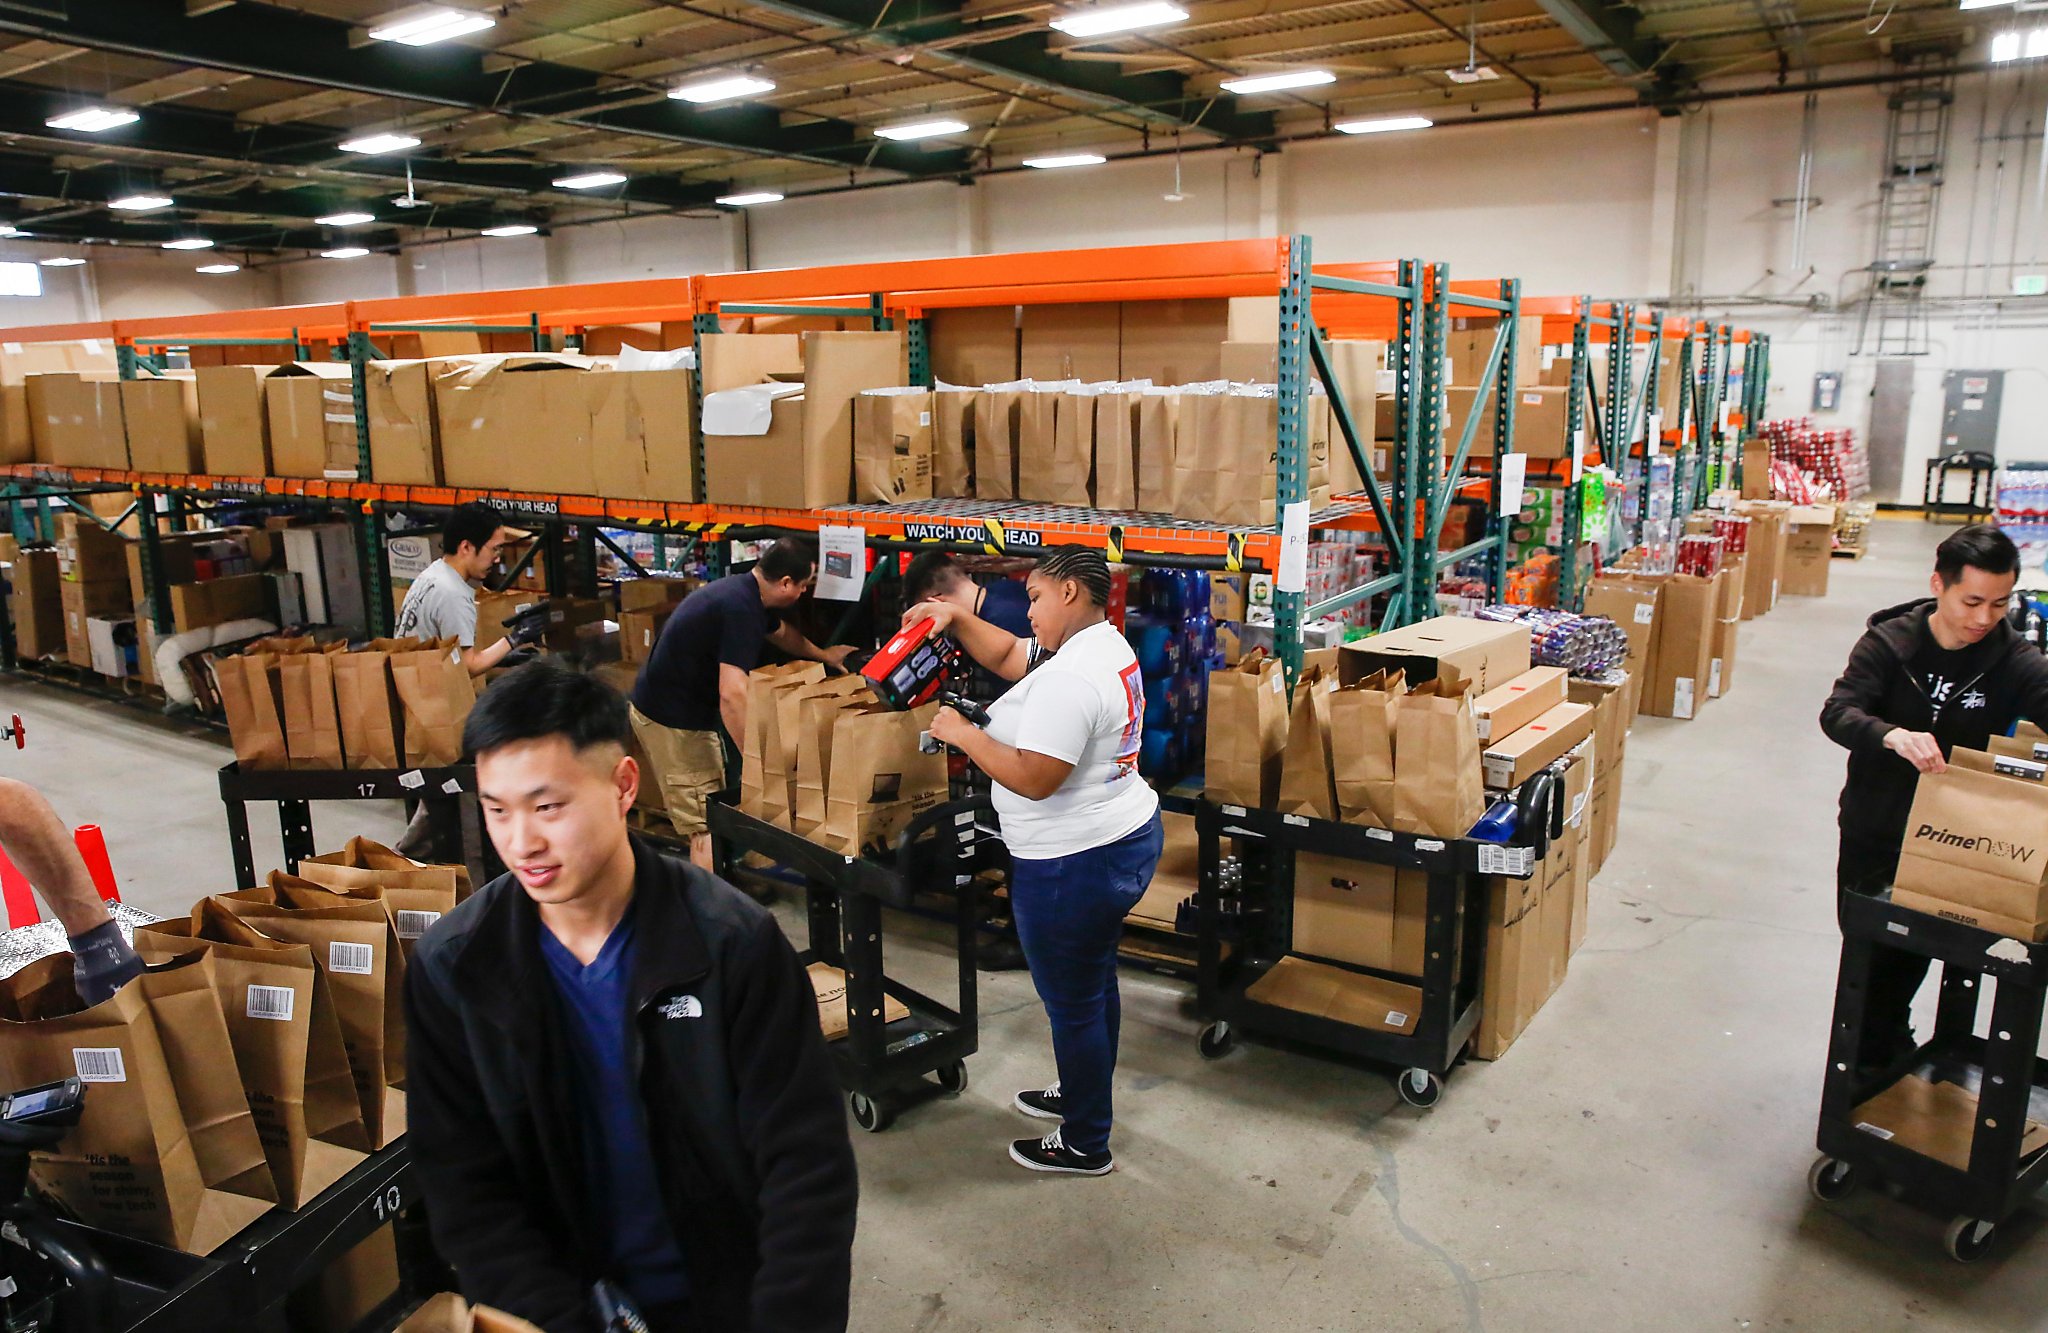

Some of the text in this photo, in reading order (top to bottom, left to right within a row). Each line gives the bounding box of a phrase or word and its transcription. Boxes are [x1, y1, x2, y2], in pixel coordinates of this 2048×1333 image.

[212, 482, 265, 494] WACH YUR HEA
[533, 502, 557, 514] HEAD
[907, 524, 1040, 546] WATCH YOU HEAD
[357, 783, 376, 797] 17
[1937, 908, 1978, 926] amazon
[107, 1154, 130, 1166] the
[373, 1185, 401, 1221] 10
